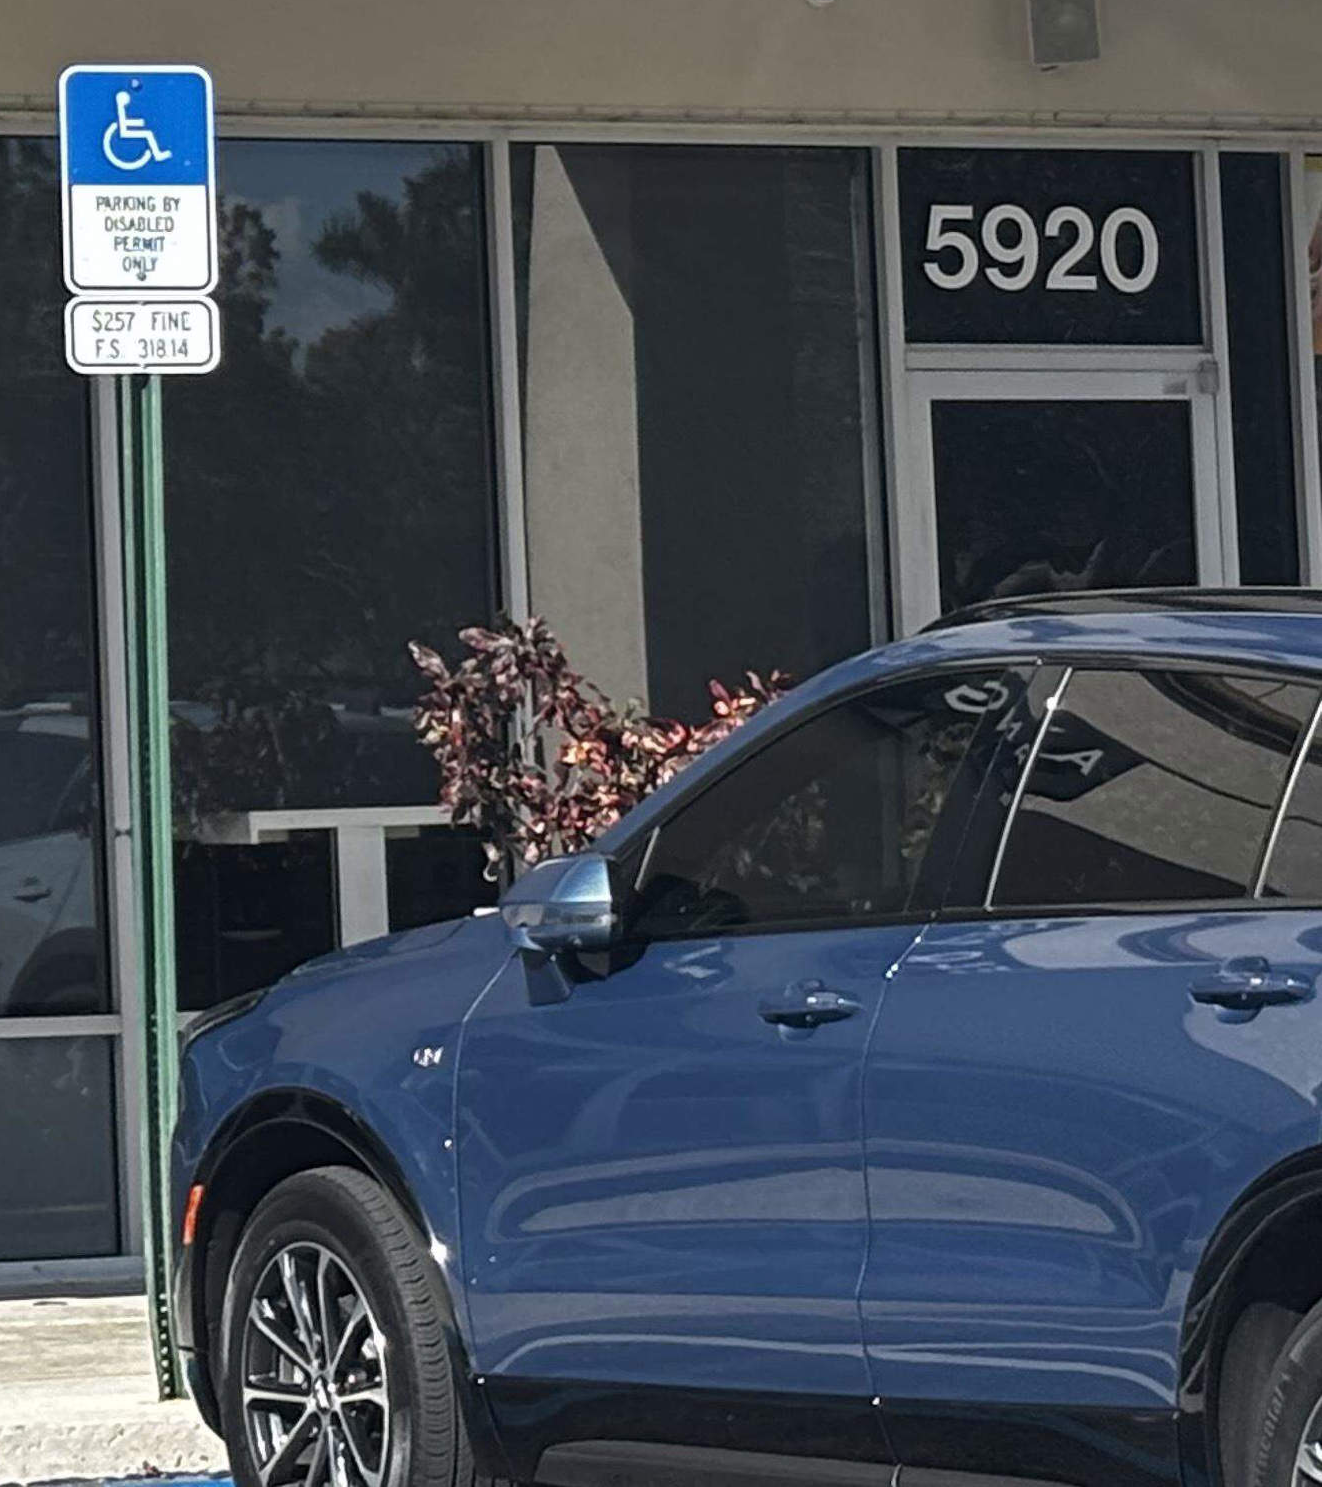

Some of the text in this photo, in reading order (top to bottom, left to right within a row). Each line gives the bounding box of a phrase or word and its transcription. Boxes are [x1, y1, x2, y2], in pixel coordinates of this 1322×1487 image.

[95, 195, 180, 212] PARKING BY
[104, 215, 175, 232] DISABLED
[113, 236, 165, 252] PERMIT
[923, 204, 1159, 294] 5920
[122, 256, 158, 273] ONLY
[92, 309, 192, 333] $257 FINE
